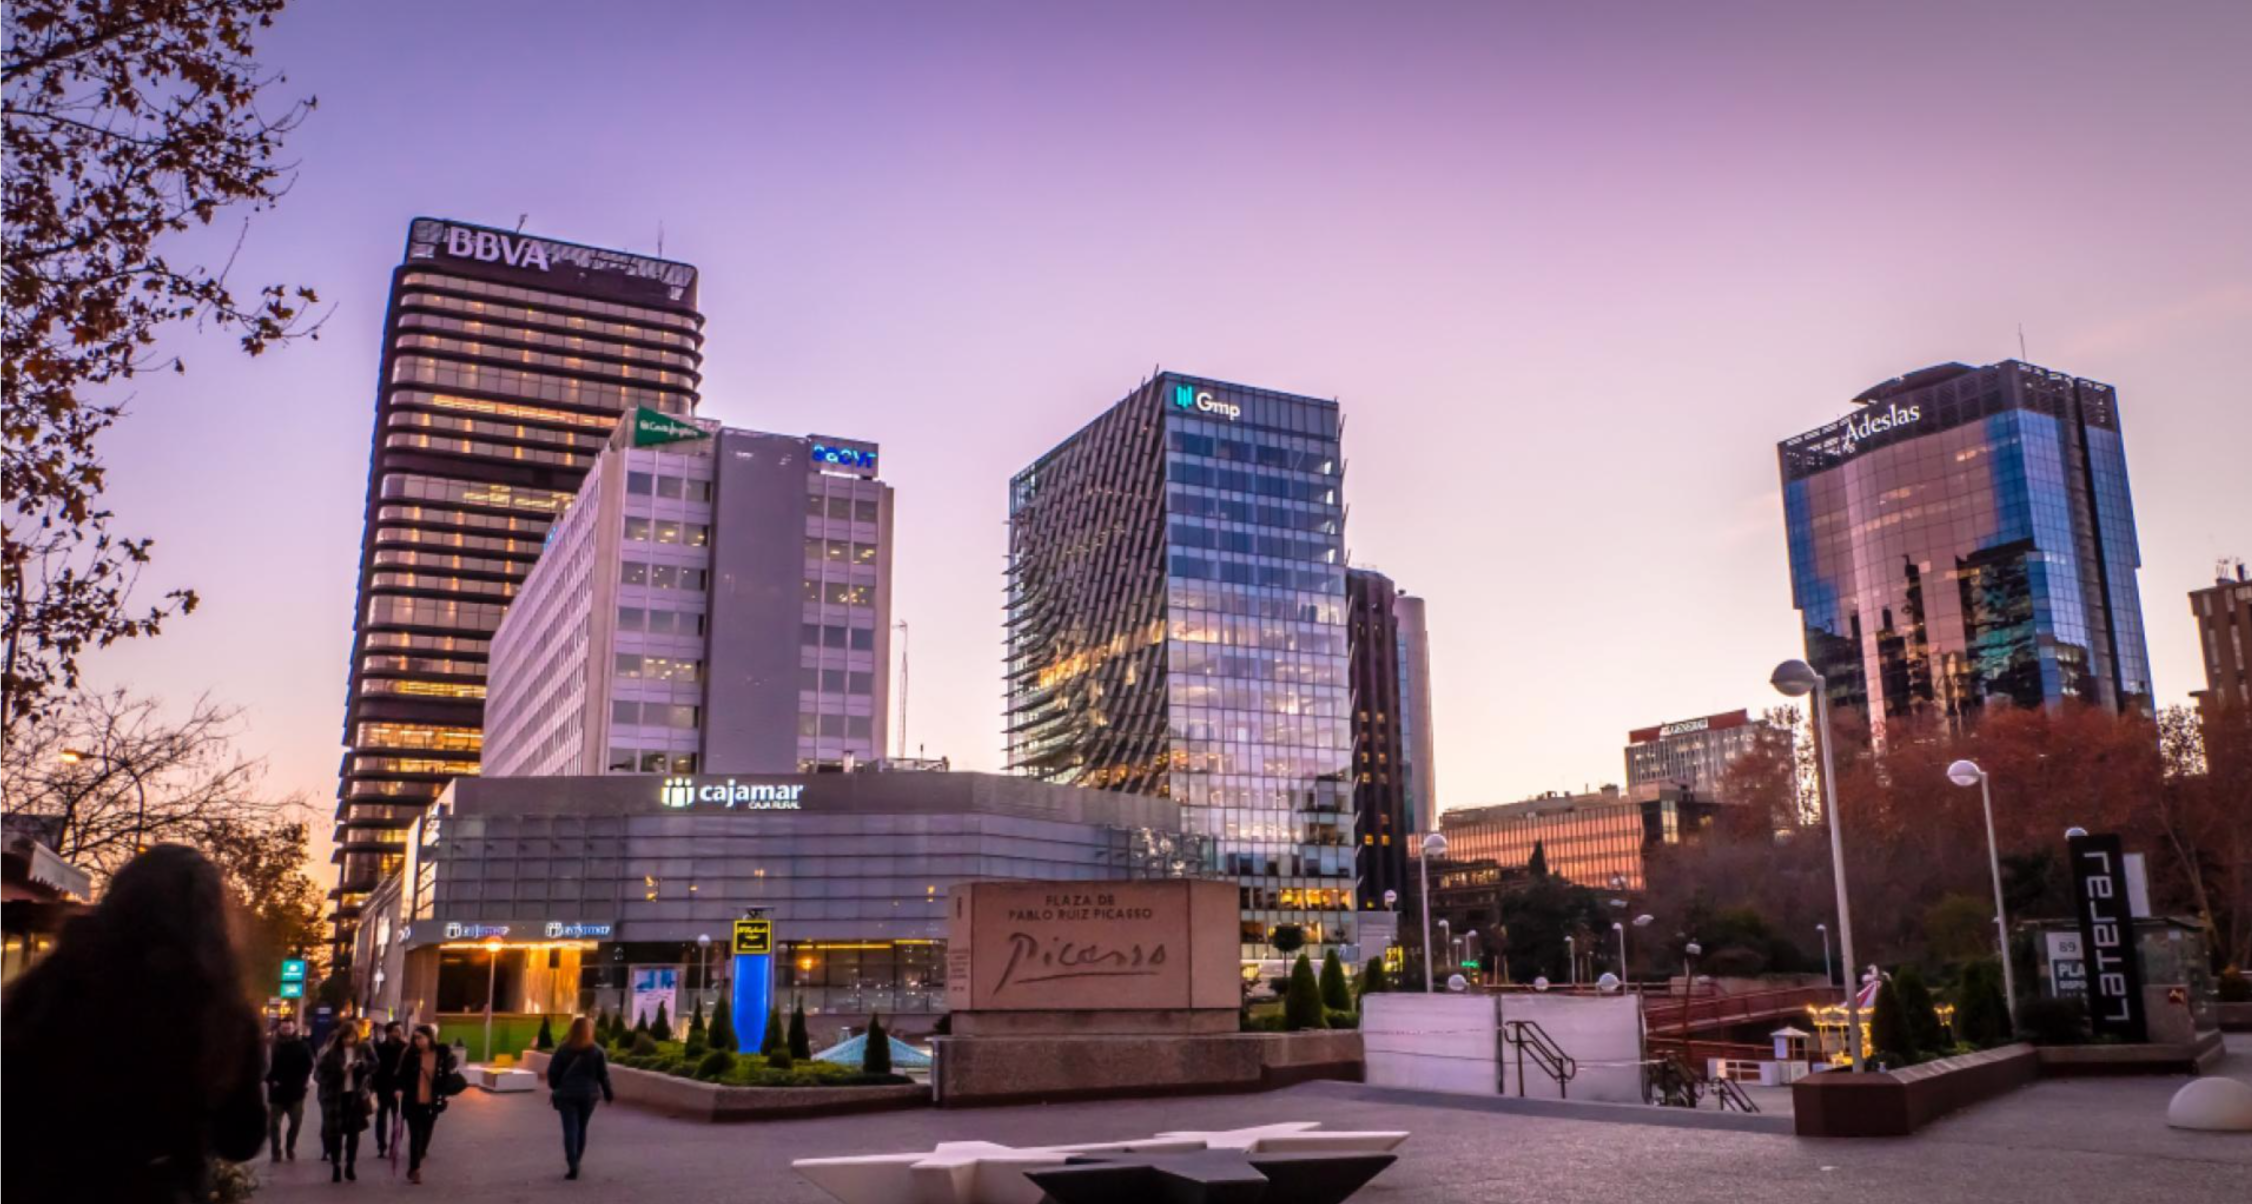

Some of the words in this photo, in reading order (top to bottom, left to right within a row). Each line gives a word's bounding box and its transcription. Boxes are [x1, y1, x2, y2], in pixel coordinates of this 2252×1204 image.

[448, 226, 550, 272] BBVA
[1196, 392, 1240, 420] Gmp
[1844, 404, 1920, 446] Adeslas
[699, 778, 803, 807] cajamar
[1045, 894, 1092, 906] PLAZA
[1098, 894, 1115, 906] DE
[1008, 908, 1054, 921] PABLO
[1058, 908, 1090, 920] RUIZ
[1094, 908, 1153, 920] PICASSO
[993, 931, 1167, 996] Picasso
[2057, 962, 2087, 978] PLA
